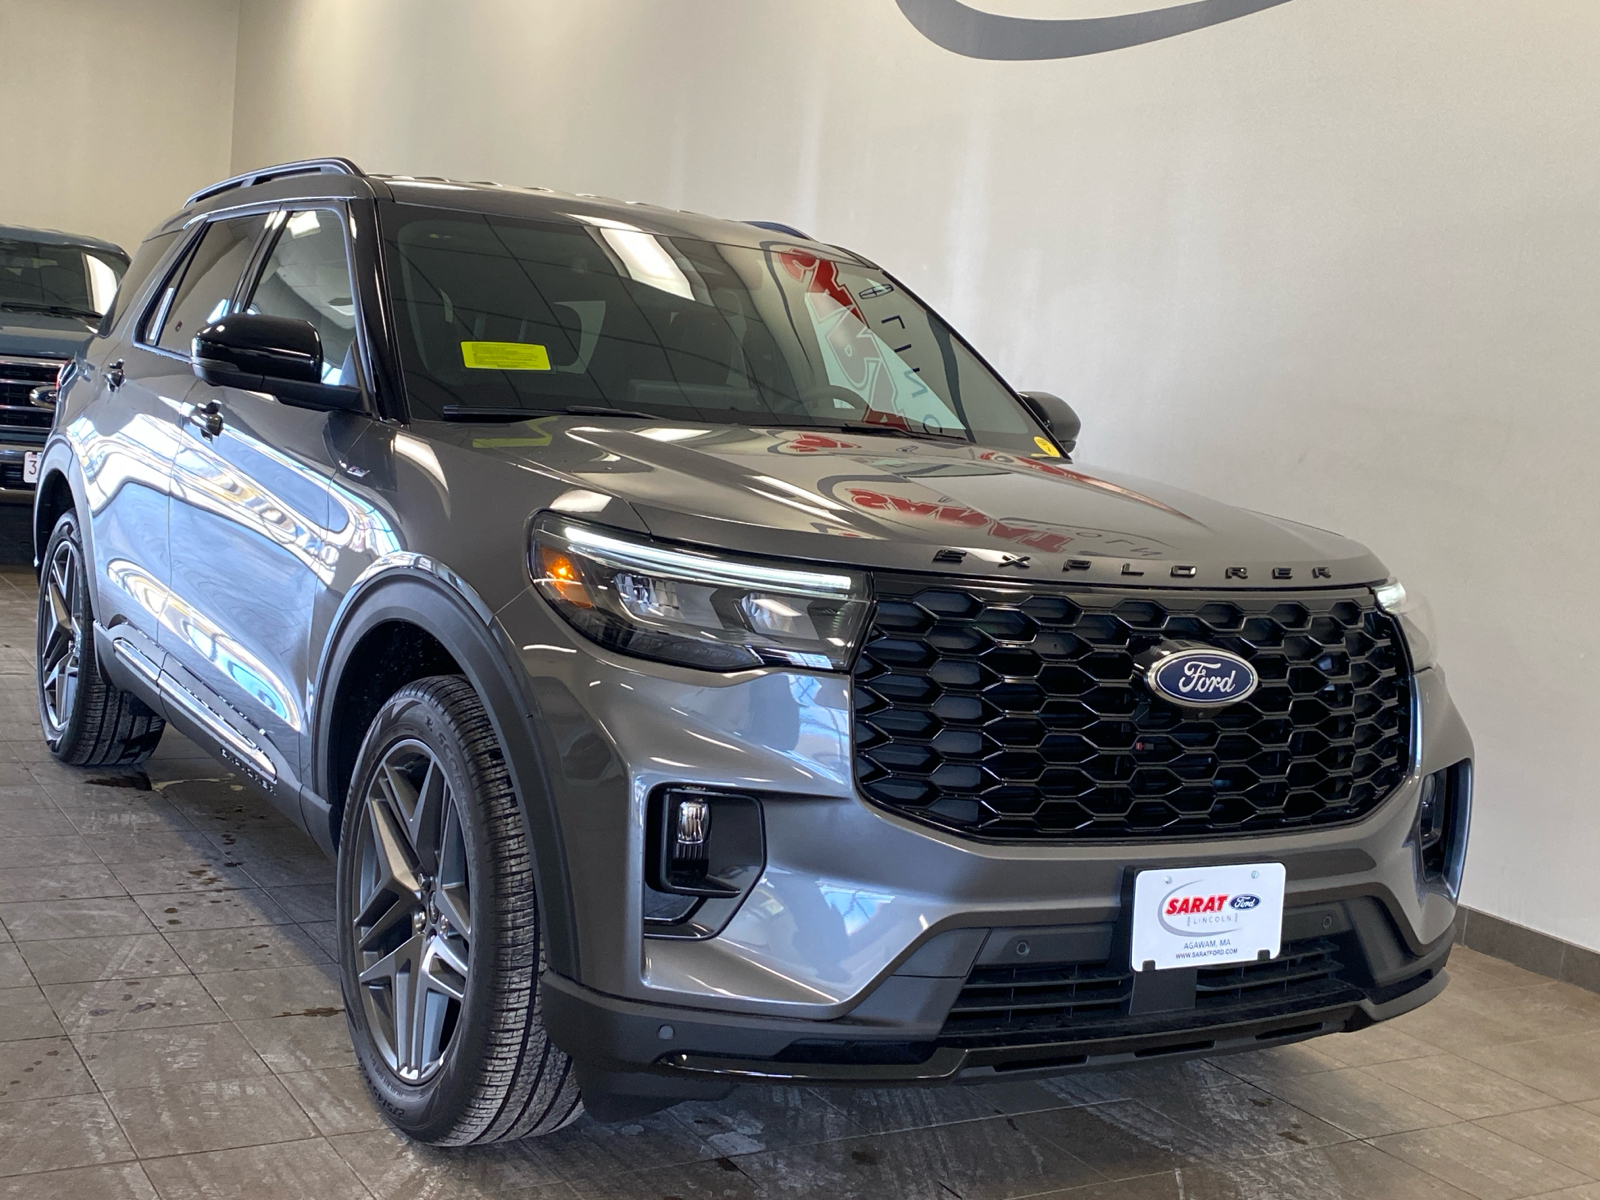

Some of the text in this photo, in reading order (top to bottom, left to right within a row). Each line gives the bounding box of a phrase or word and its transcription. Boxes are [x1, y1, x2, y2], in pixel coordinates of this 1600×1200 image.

[932, 549, 1332, 580] EXPLORER
[1178, 661, 1237, 693] Ford
[1165, 894, 1256, 915] SARAT Ford
[1193, 915, 1232, 924] LINCOLN
[1184, 939, 1231, 949] AGAWAM, MA
[1175, 948, 1238, 959] WWW.SARATFORD.COM
